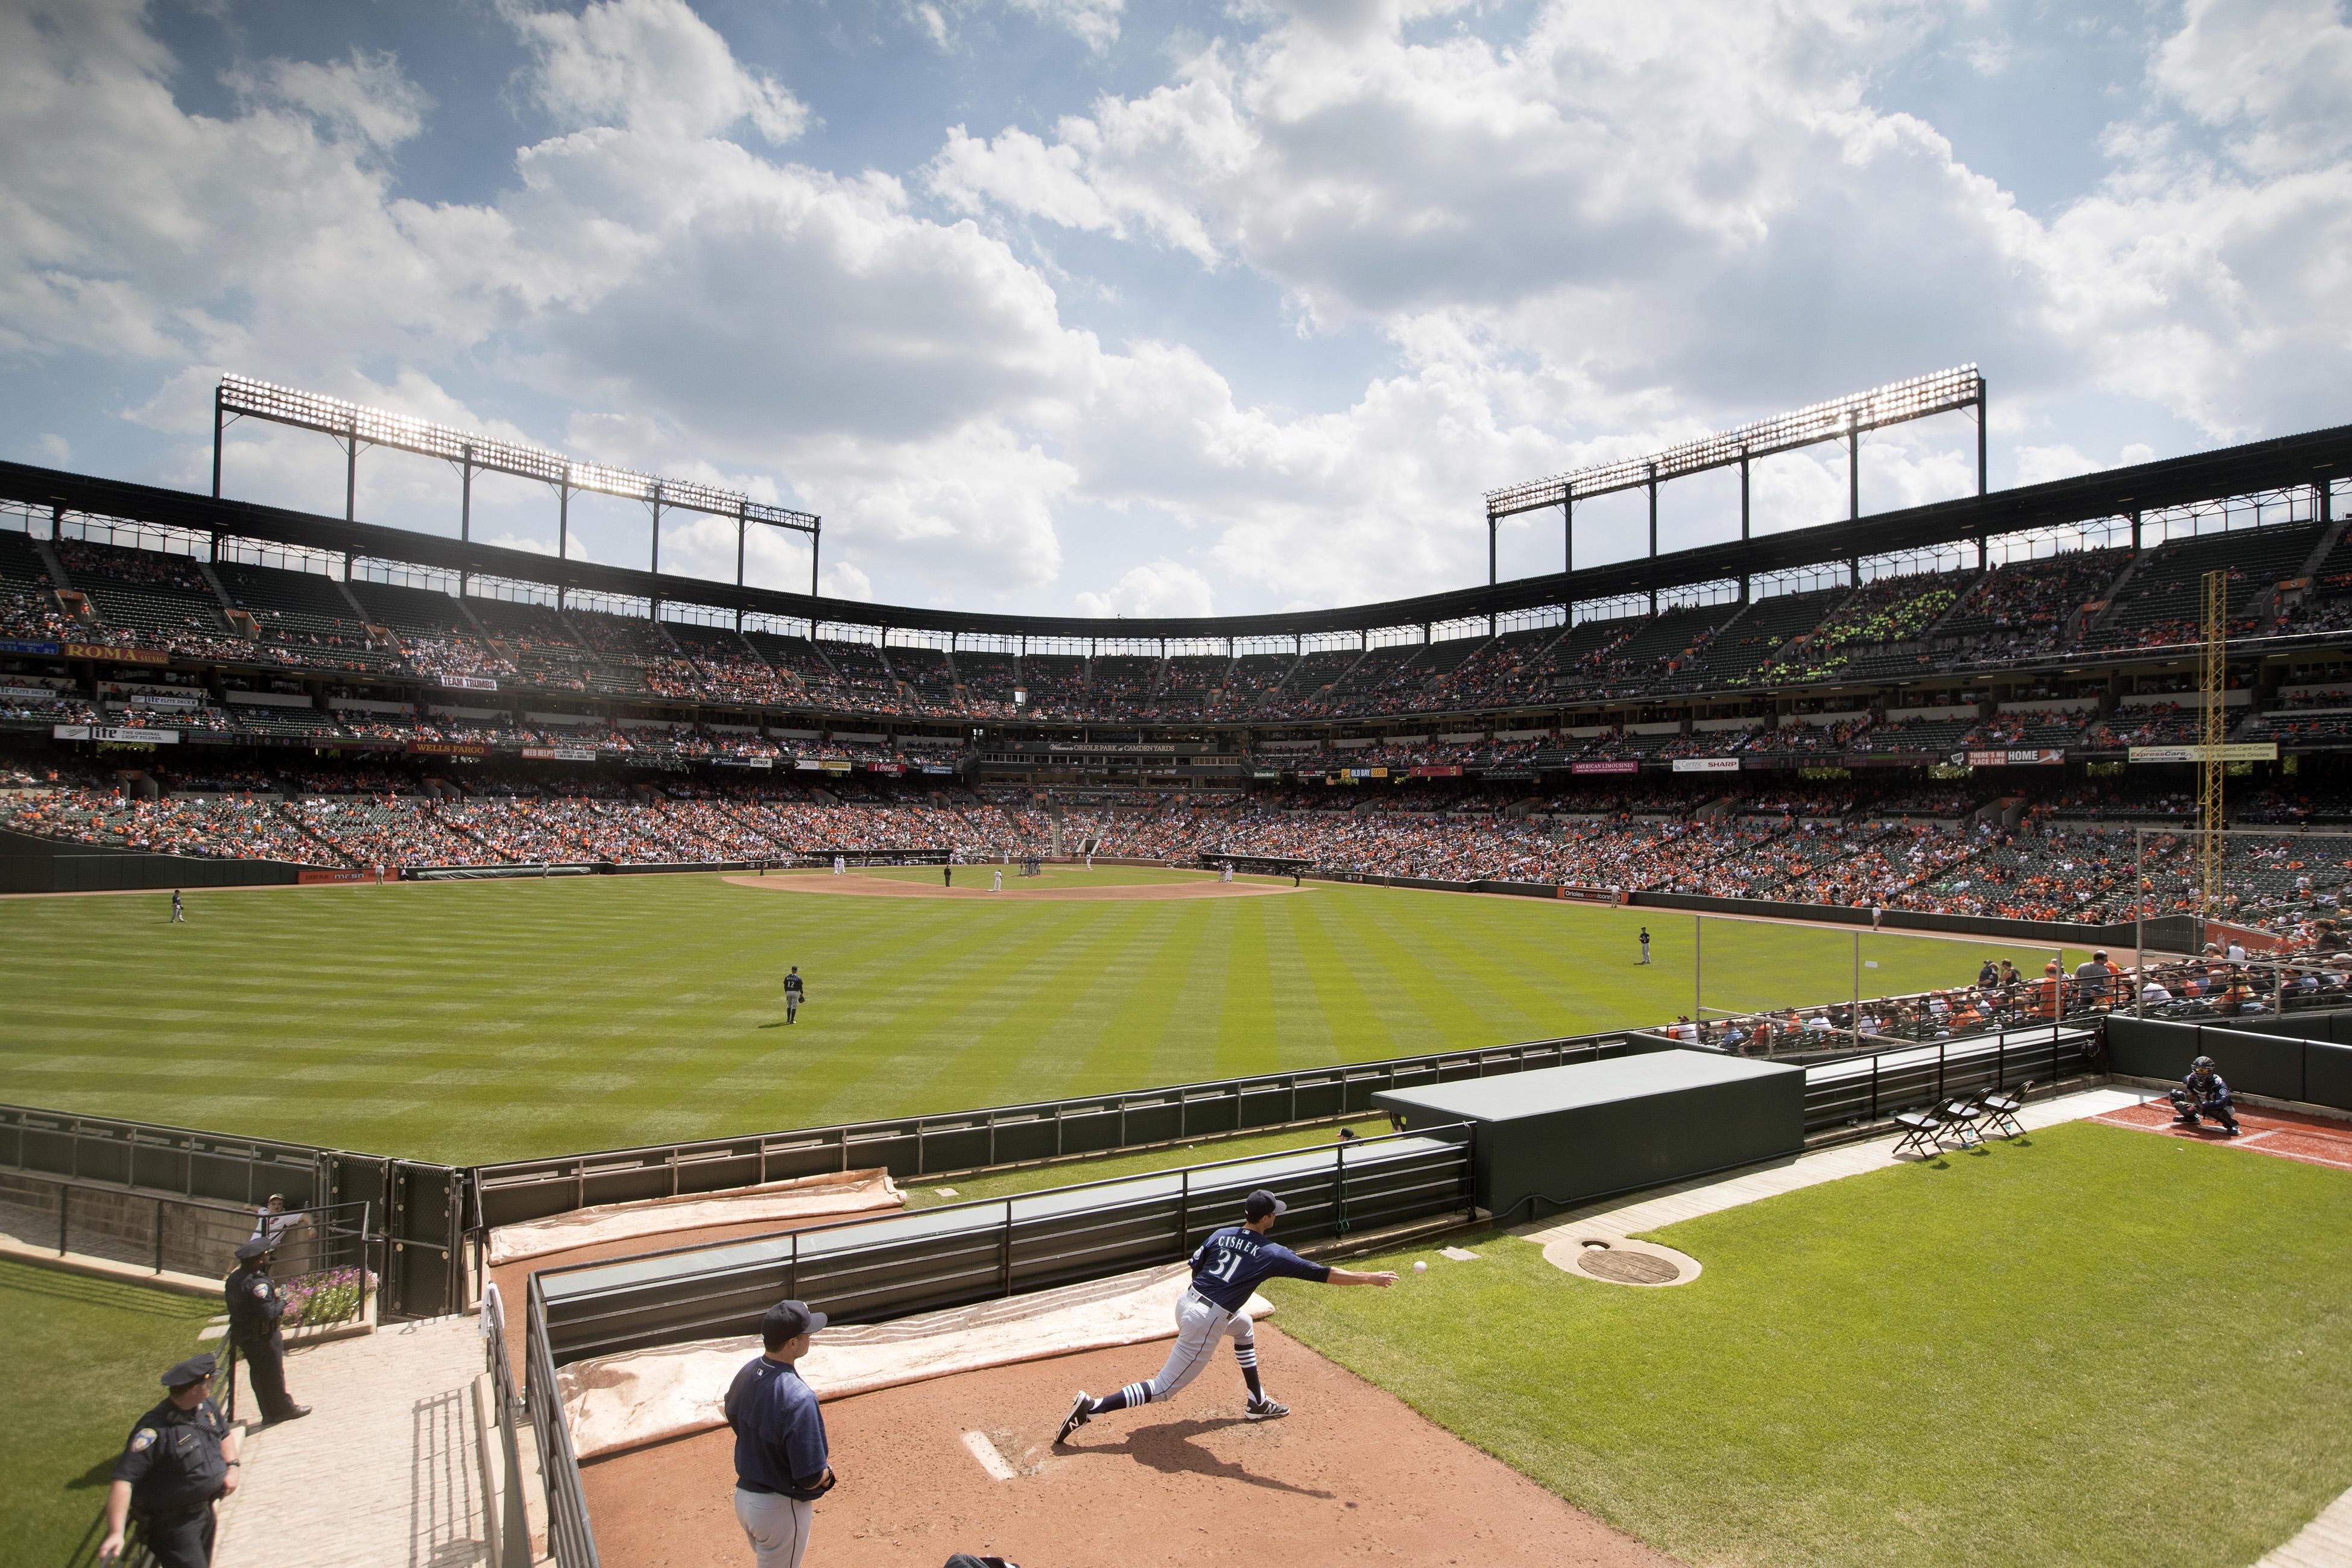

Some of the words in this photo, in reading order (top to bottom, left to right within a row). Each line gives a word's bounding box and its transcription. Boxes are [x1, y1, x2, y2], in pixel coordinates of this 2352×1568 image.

[67, 644, 138, 661] ROMA
[443, 677, 464, 686] TEAM
[465, 678, 495, 689] TRUMBO
[417, 744, 450, 752] WELLS
[453, 745, 484, 754] FARGO
[2008, 750, 2038, 760] HOME
[1565, 890, 1620, 900] Orioles.com/connt
[1218, 1236, 1260, 1256] CISHEK
[1209, 1249, 1242, 1283] 31
